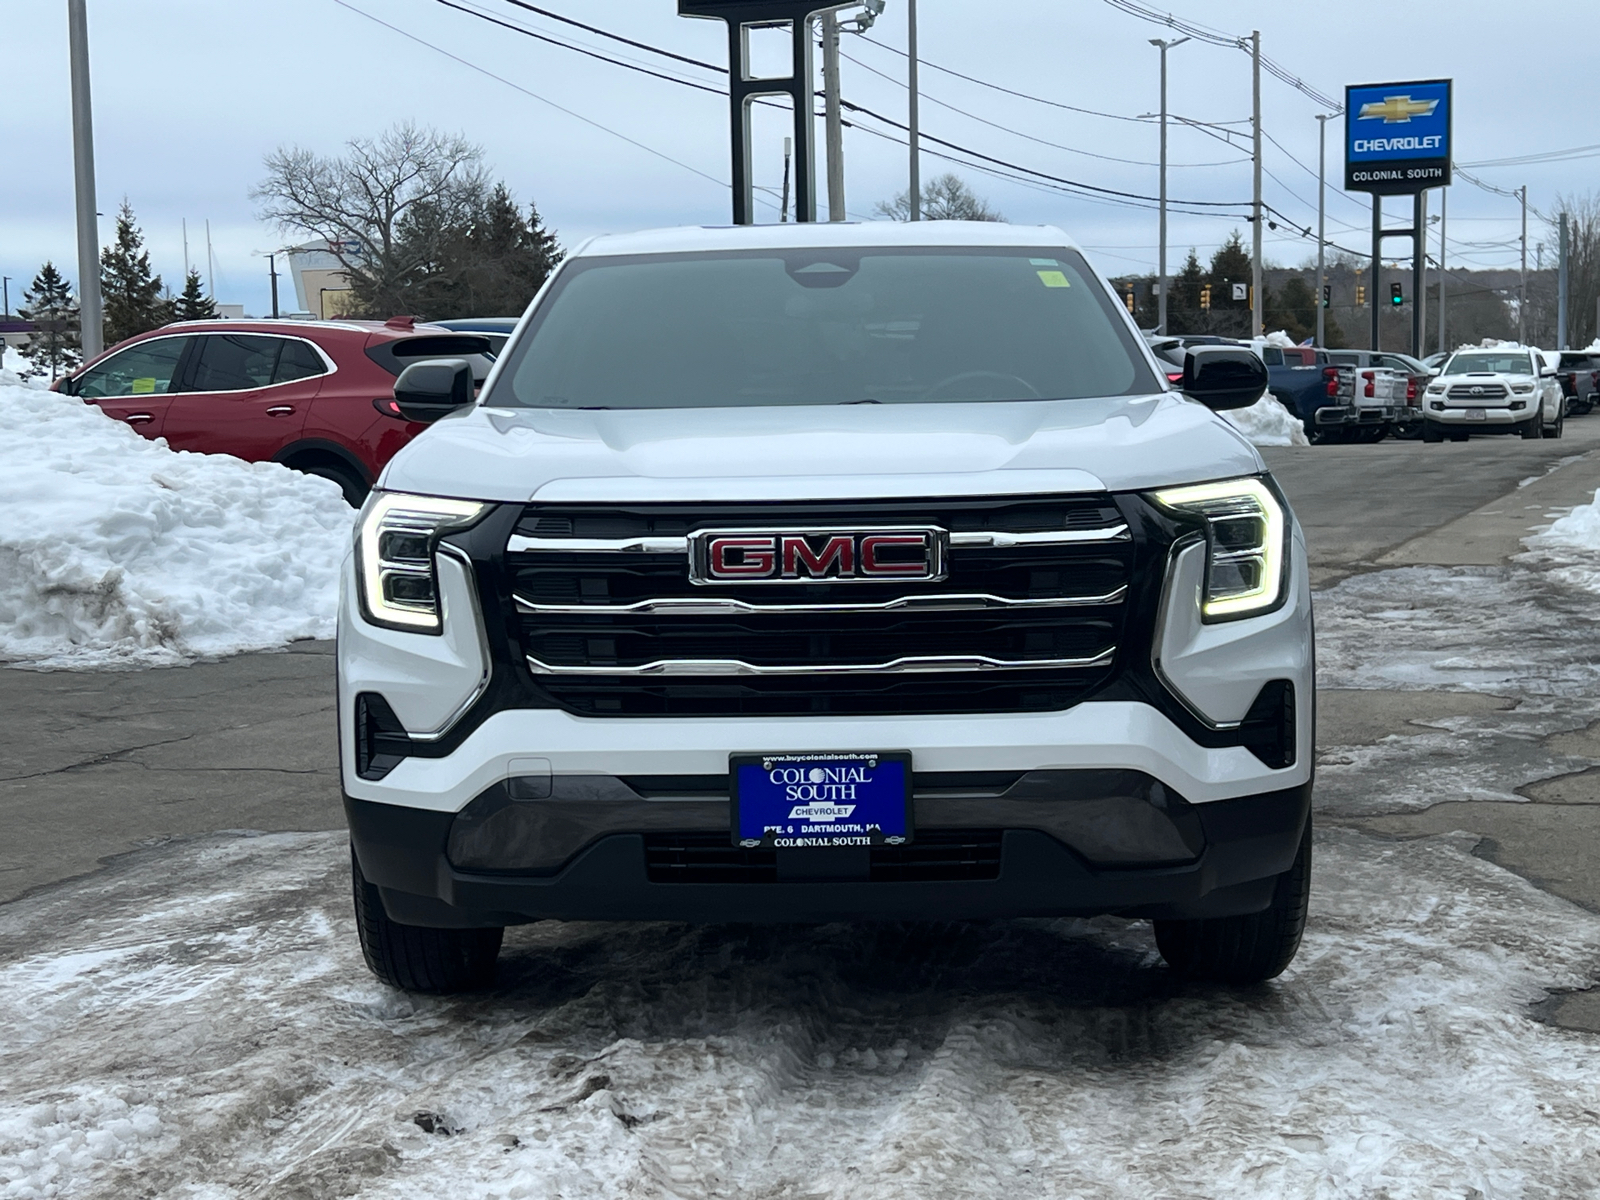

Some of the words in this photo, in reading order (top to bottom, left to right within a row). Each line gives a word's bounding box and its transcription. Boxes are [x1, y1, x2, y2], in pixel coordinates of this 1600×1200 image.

[1354, 135, 1442, 152] CHEVROLET
[1353, 170, 1403, 182] COLONIAL
[1407, 168, 1442, 179] SOUTH
[709, 535, 929, 579] GMC
[763, 753, 878, 763] www.buycolonialsouth.com
[769, 767, 873, 785] COLONIAL
[786, 784, 857, 801] SOUTH
[795, 807, 849, 816] CHEVROLET
[787, 826, 794, 834] 6
[801, 824, 864, 834] DARTMOUTH,
[774, 837, 832, 847] COLONIAL
[833, 836, 871, 846] SOUTH
